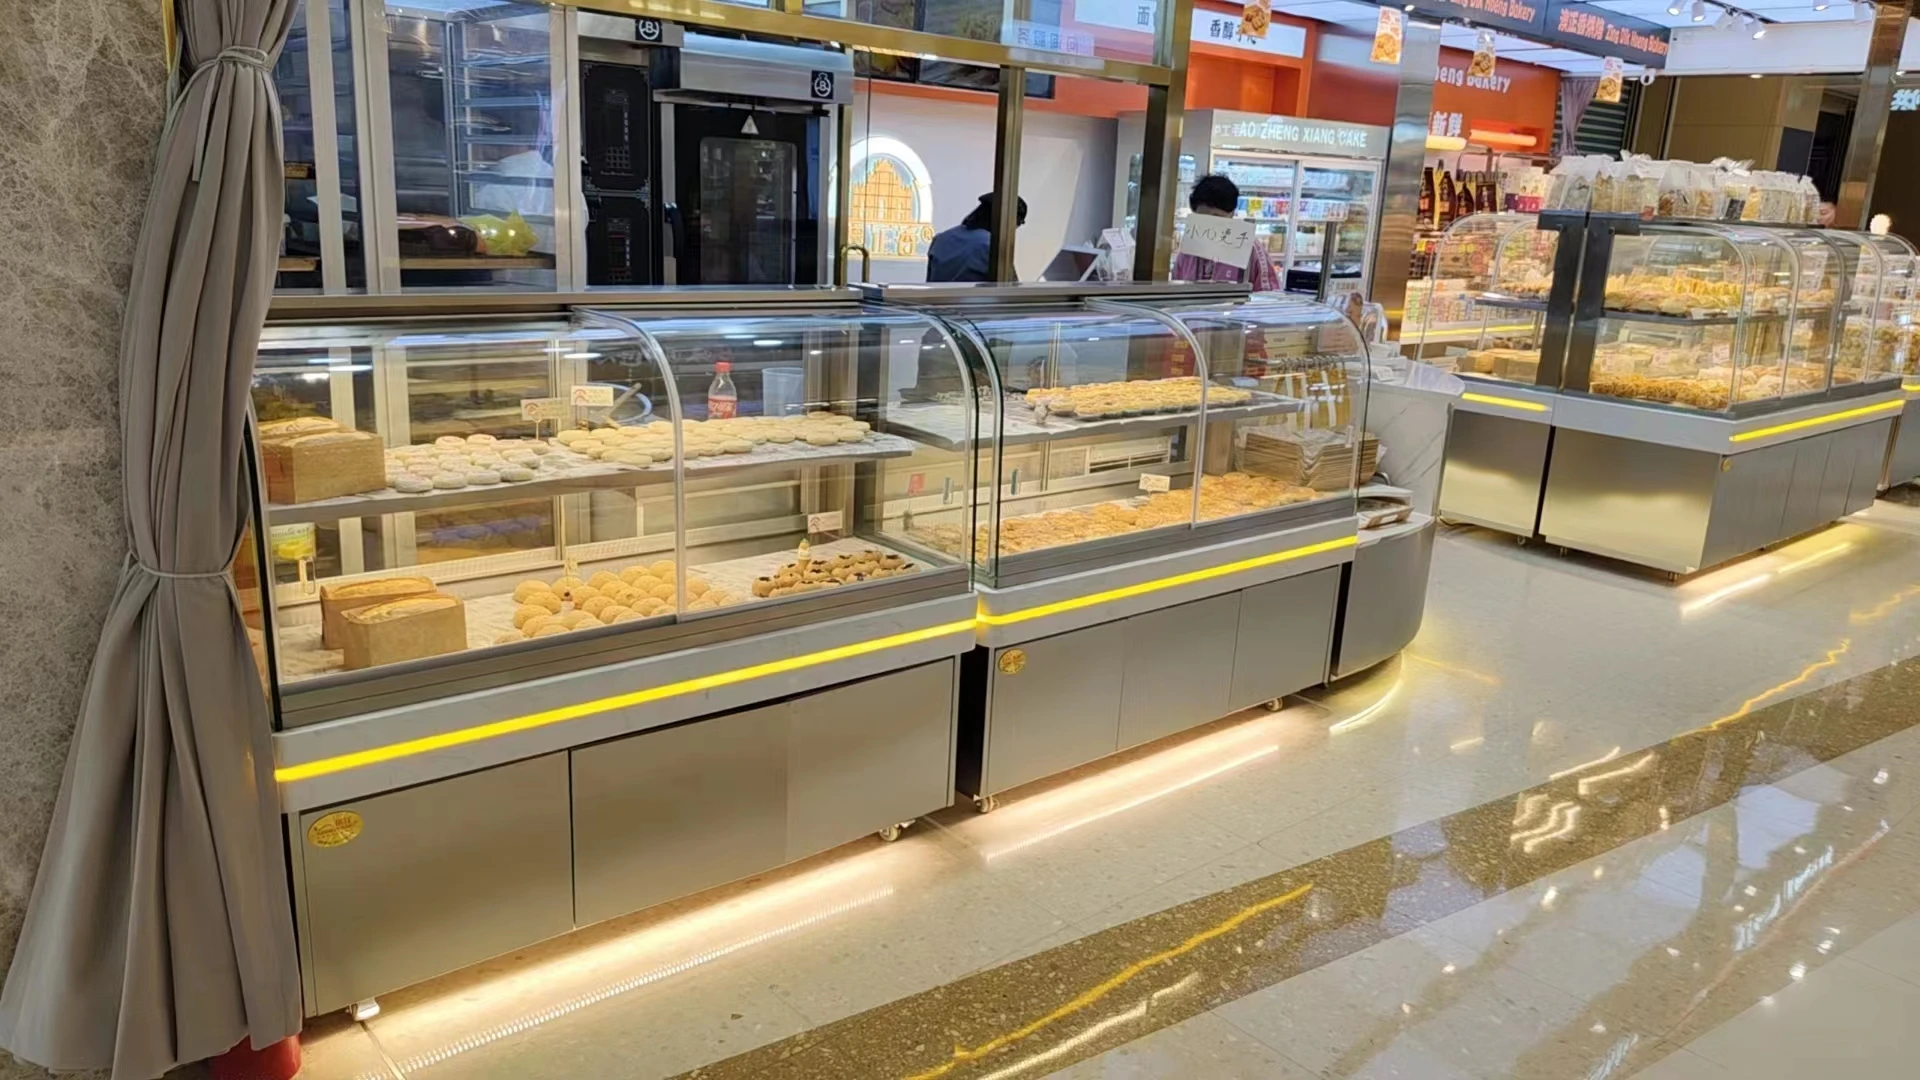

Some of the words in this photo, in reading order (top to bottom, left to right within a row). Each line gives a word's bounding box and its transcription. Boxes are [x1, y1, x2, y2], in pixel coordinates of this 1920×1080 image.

[1507, 0, 1536, 23] Bakery
[1435, 66, 1464, 87] eng
[1239, 121, 1256, 138] AO
[1260, 122, 1300, 142] ZHENG
[1302, 127, 1335, 145] XIANG
[1338, 129, 1369, 148] CAKE
[1428, 111, 1463, 138] 新鲜
